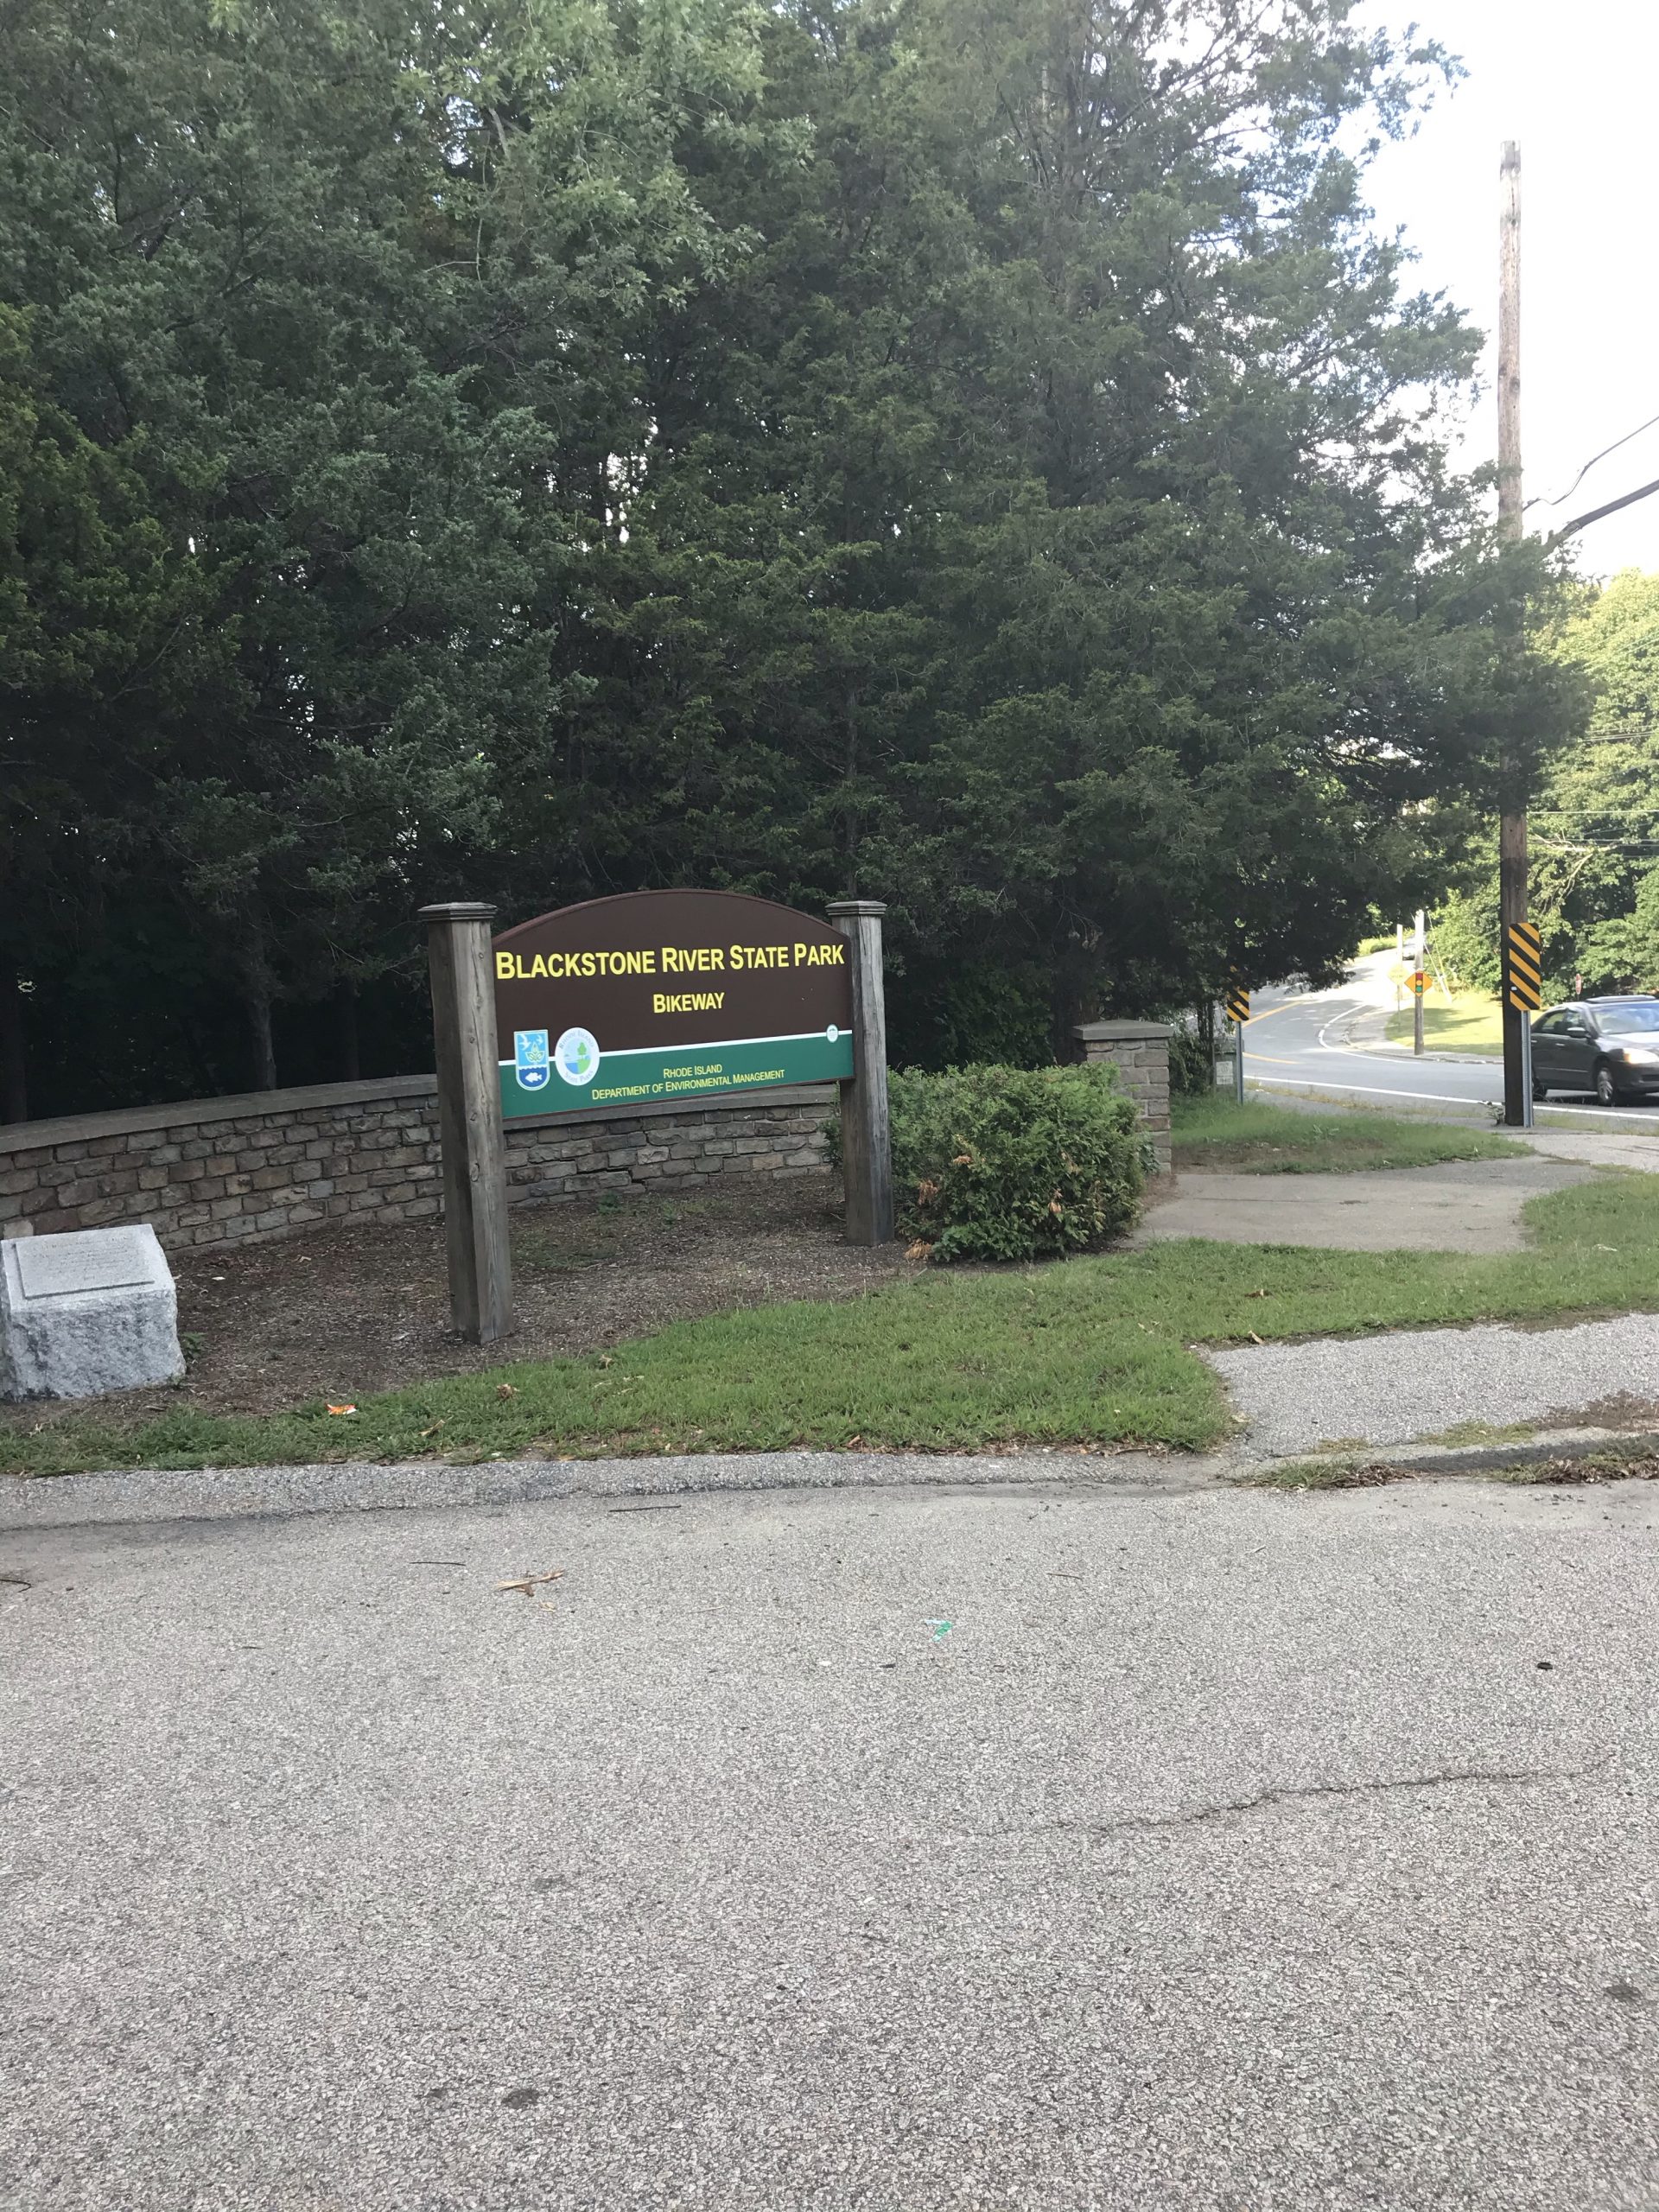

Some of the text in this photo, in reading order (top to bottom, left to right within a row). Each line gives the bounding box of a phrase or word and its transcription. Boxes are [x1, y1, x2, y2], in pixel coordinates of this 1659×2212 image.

[495, 943, 845, 980] BLACKSTONE RIVER STATE PARK
[652, 992, 725, 1014] BIKEWAY
[663, 1064, 722, 1078] RHODE ISLAND
[592, 1069, 785, 1100] DEPARTMENT OF ENVIRONMENTAL MANAGEMENT
